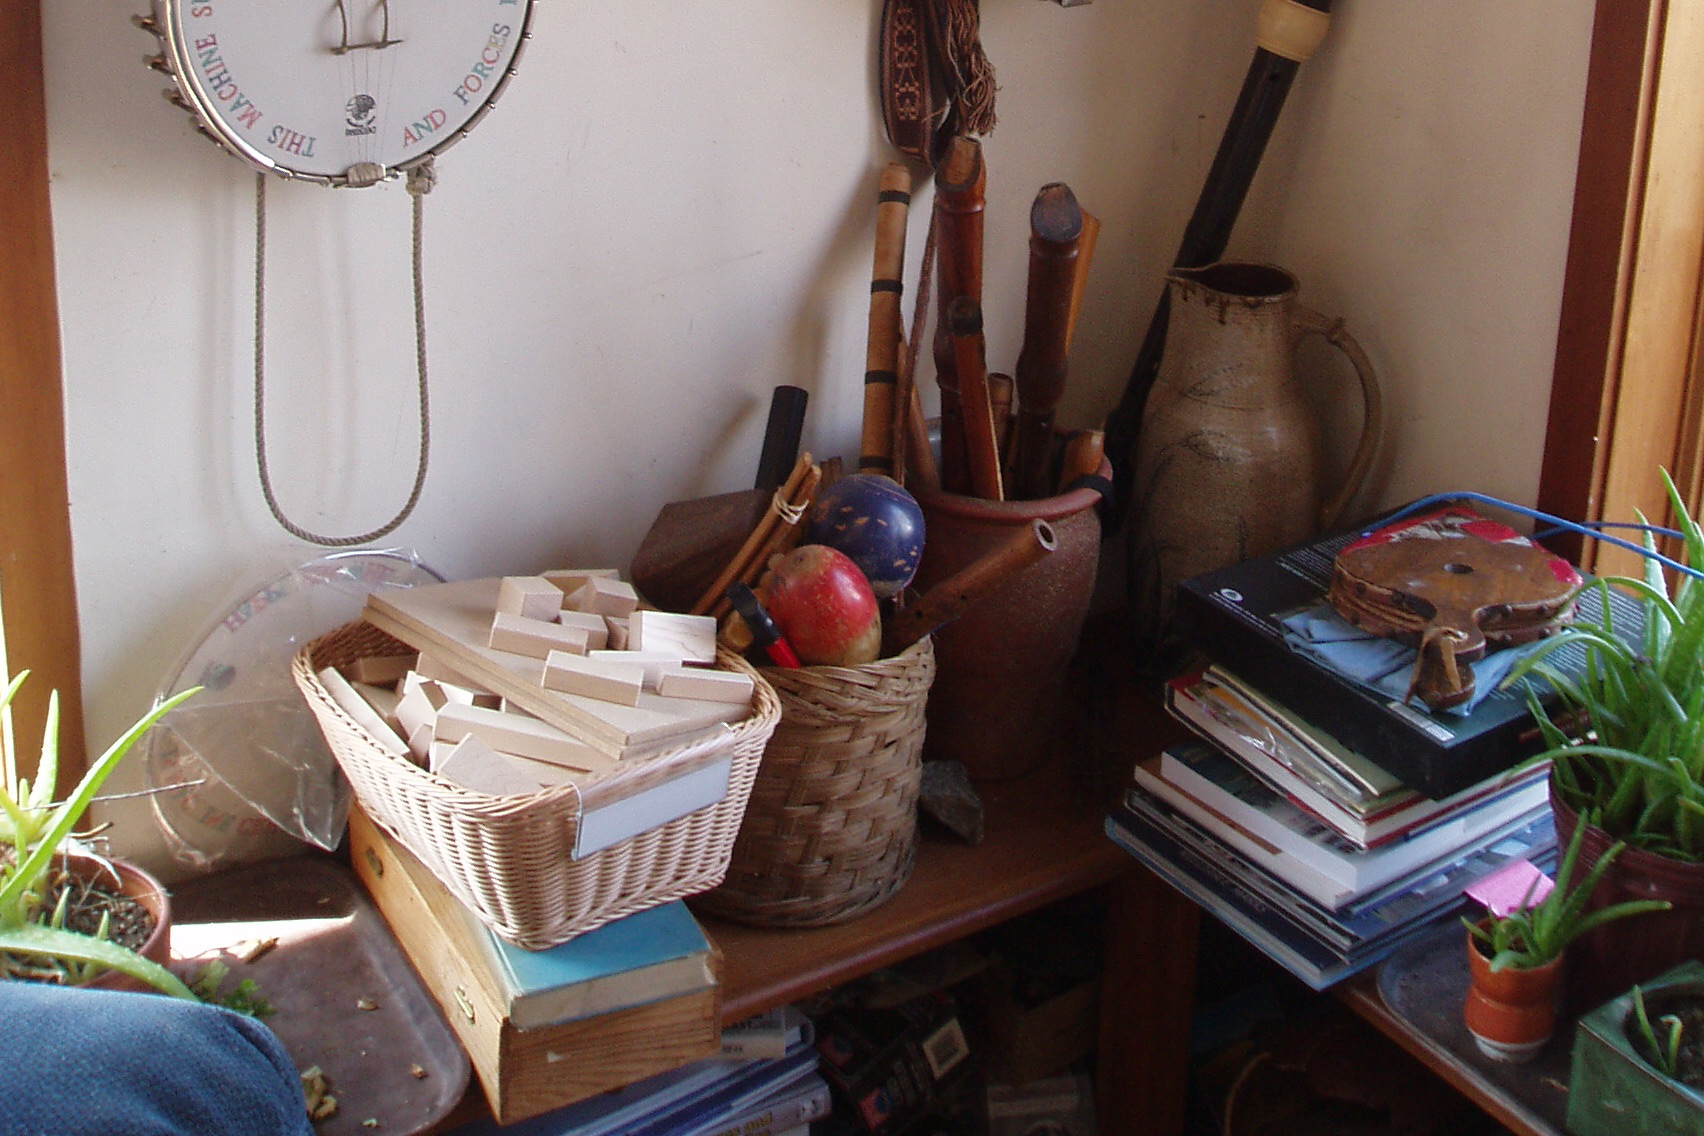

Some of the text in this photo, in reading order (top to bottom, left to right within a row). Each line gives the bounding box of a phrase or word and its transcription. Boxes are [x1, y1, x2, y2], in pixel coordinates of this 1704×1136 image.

[195, 33, 263, 129] MACHINE
[403, 109, 447, 149] AND
[452, 23, 511, 105] FORCES
[267, 125, 316, 157] THIS
